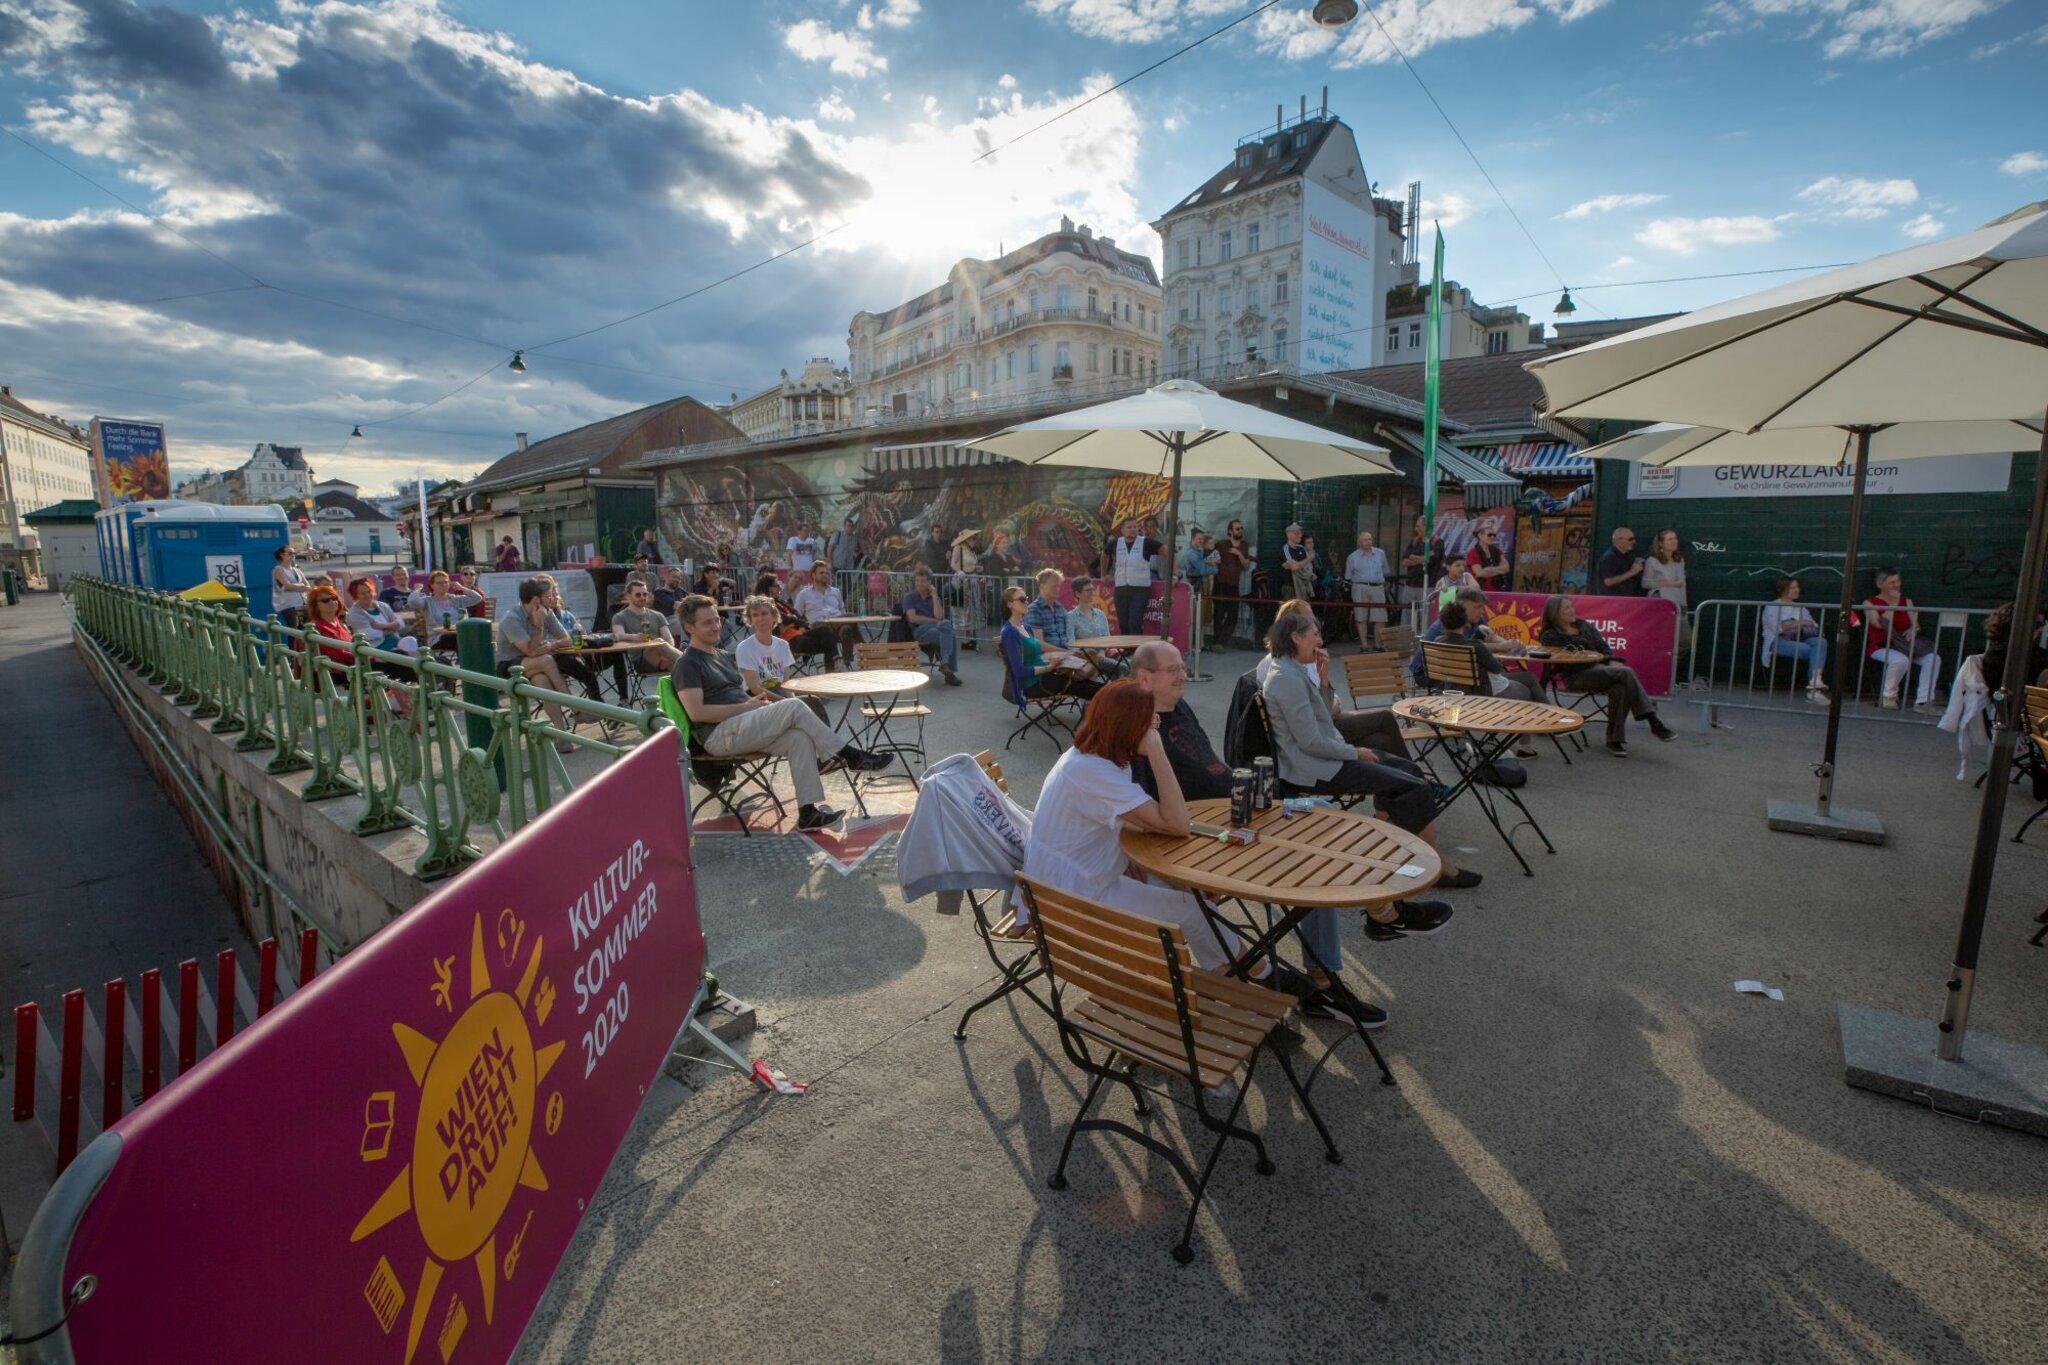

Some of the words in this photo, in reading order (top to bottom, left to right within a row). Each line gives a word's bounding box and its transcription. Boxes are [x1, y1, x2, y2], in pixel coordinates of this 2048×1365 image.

[1733, 481, 1749, 491] Die
[1750, 480, 1780, 490] Online
[568, 839, 650, 951] KULTUR-
[573, 881, 657, 1015] SOMMER
[435, 1026, 504, 1150] WIEN
[582, 981, 629, 1080] 2020
[438, 1044, 517, 1203] DREHT
[467, 1095, 518, 1211] AUF!
